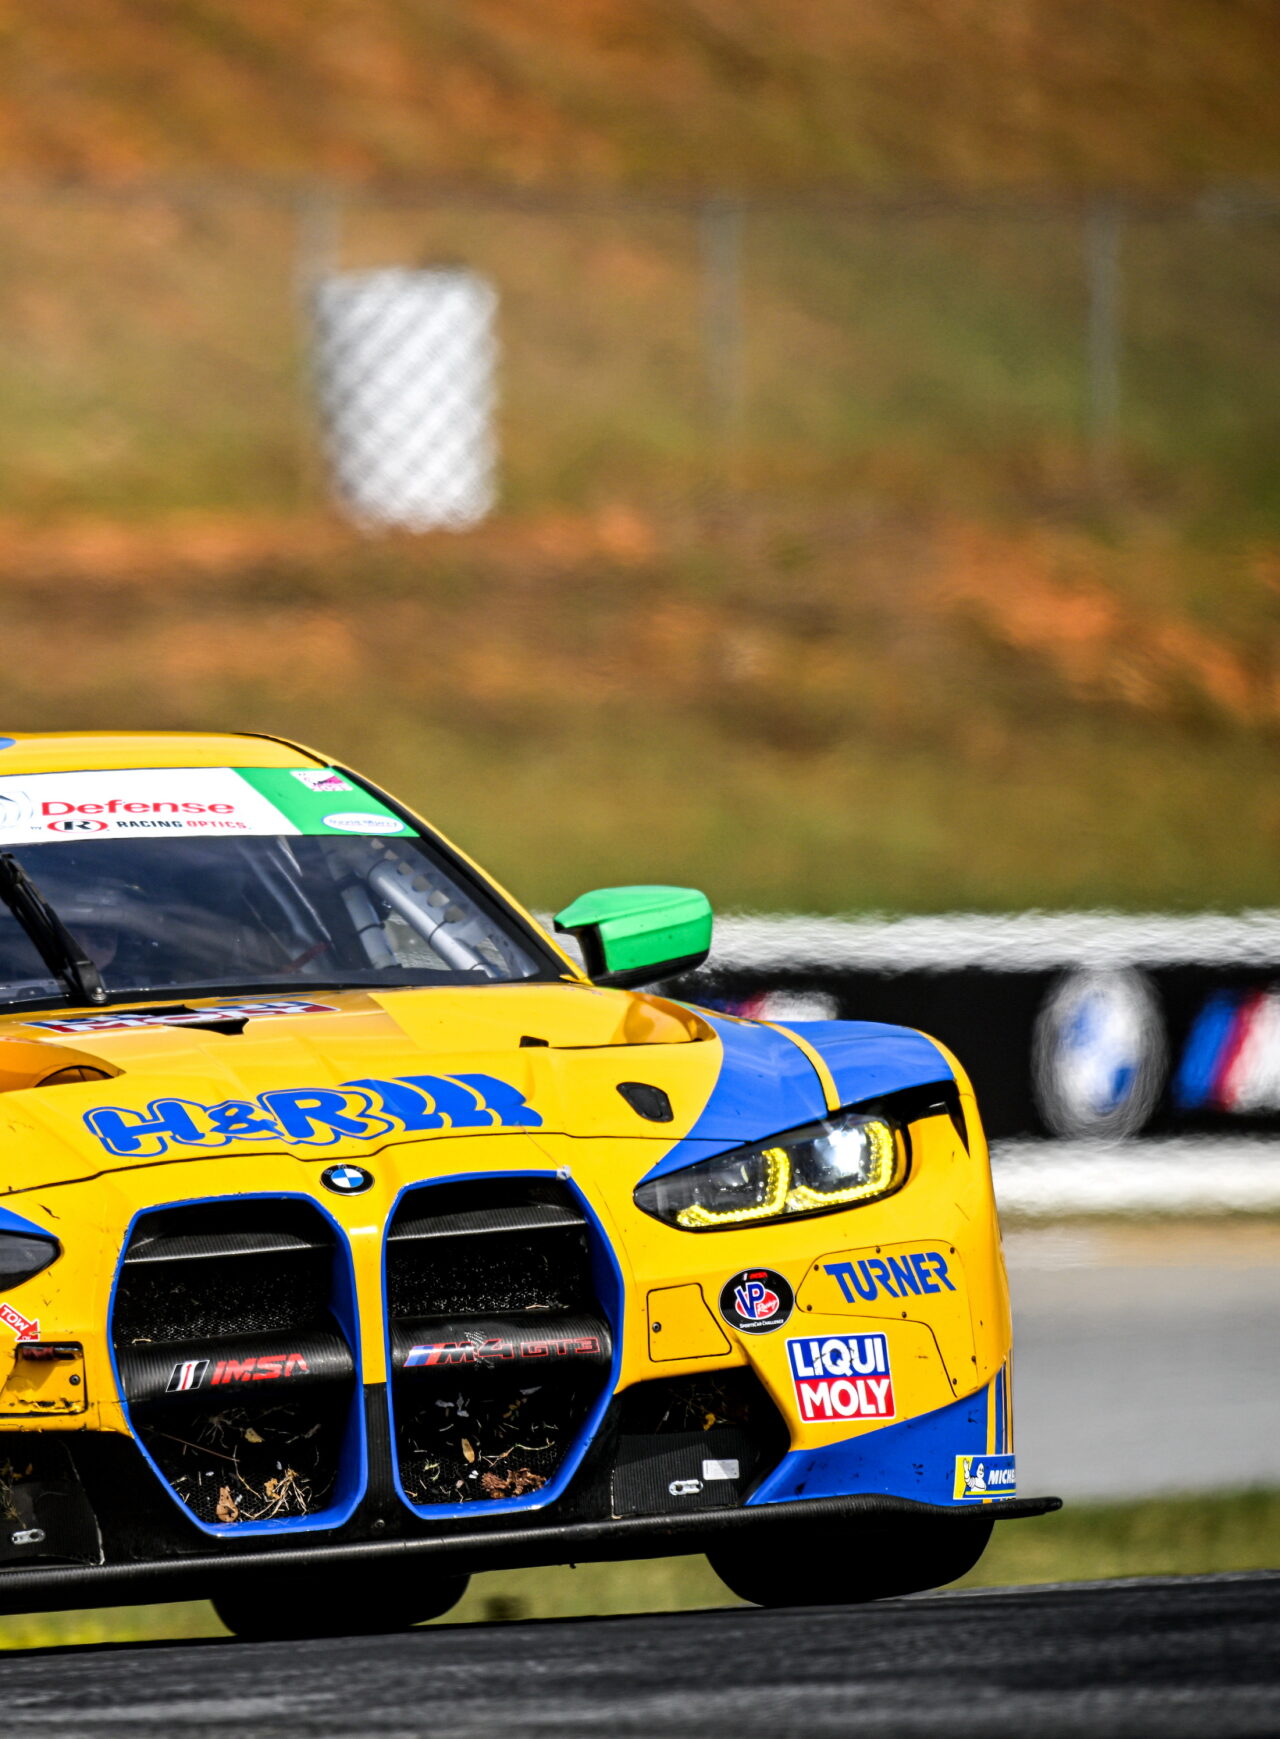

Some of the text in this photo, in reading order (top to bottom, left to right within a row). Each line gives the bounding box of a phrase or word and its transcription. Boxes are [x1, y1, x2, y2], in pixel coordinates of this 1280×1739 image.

[41, 799, 235, 816] Defense
[116, 820, 183, 828] RACING
[186, 820, 247, 829] OPTICS
[83, 1087, 394, 1158] H&R
[823, 1252, 957, 1303] TURNER
[734, 1281, 766, 1319] VP
[1, 1306, 29, 1331] TOW
[520, 1337, 601, 1359] GT3
[792, 1338, 886, 1377] LIQUI
[210, 1353, 310, 1386] IMSA
[800, 1378, 891, 1418] MOLY
